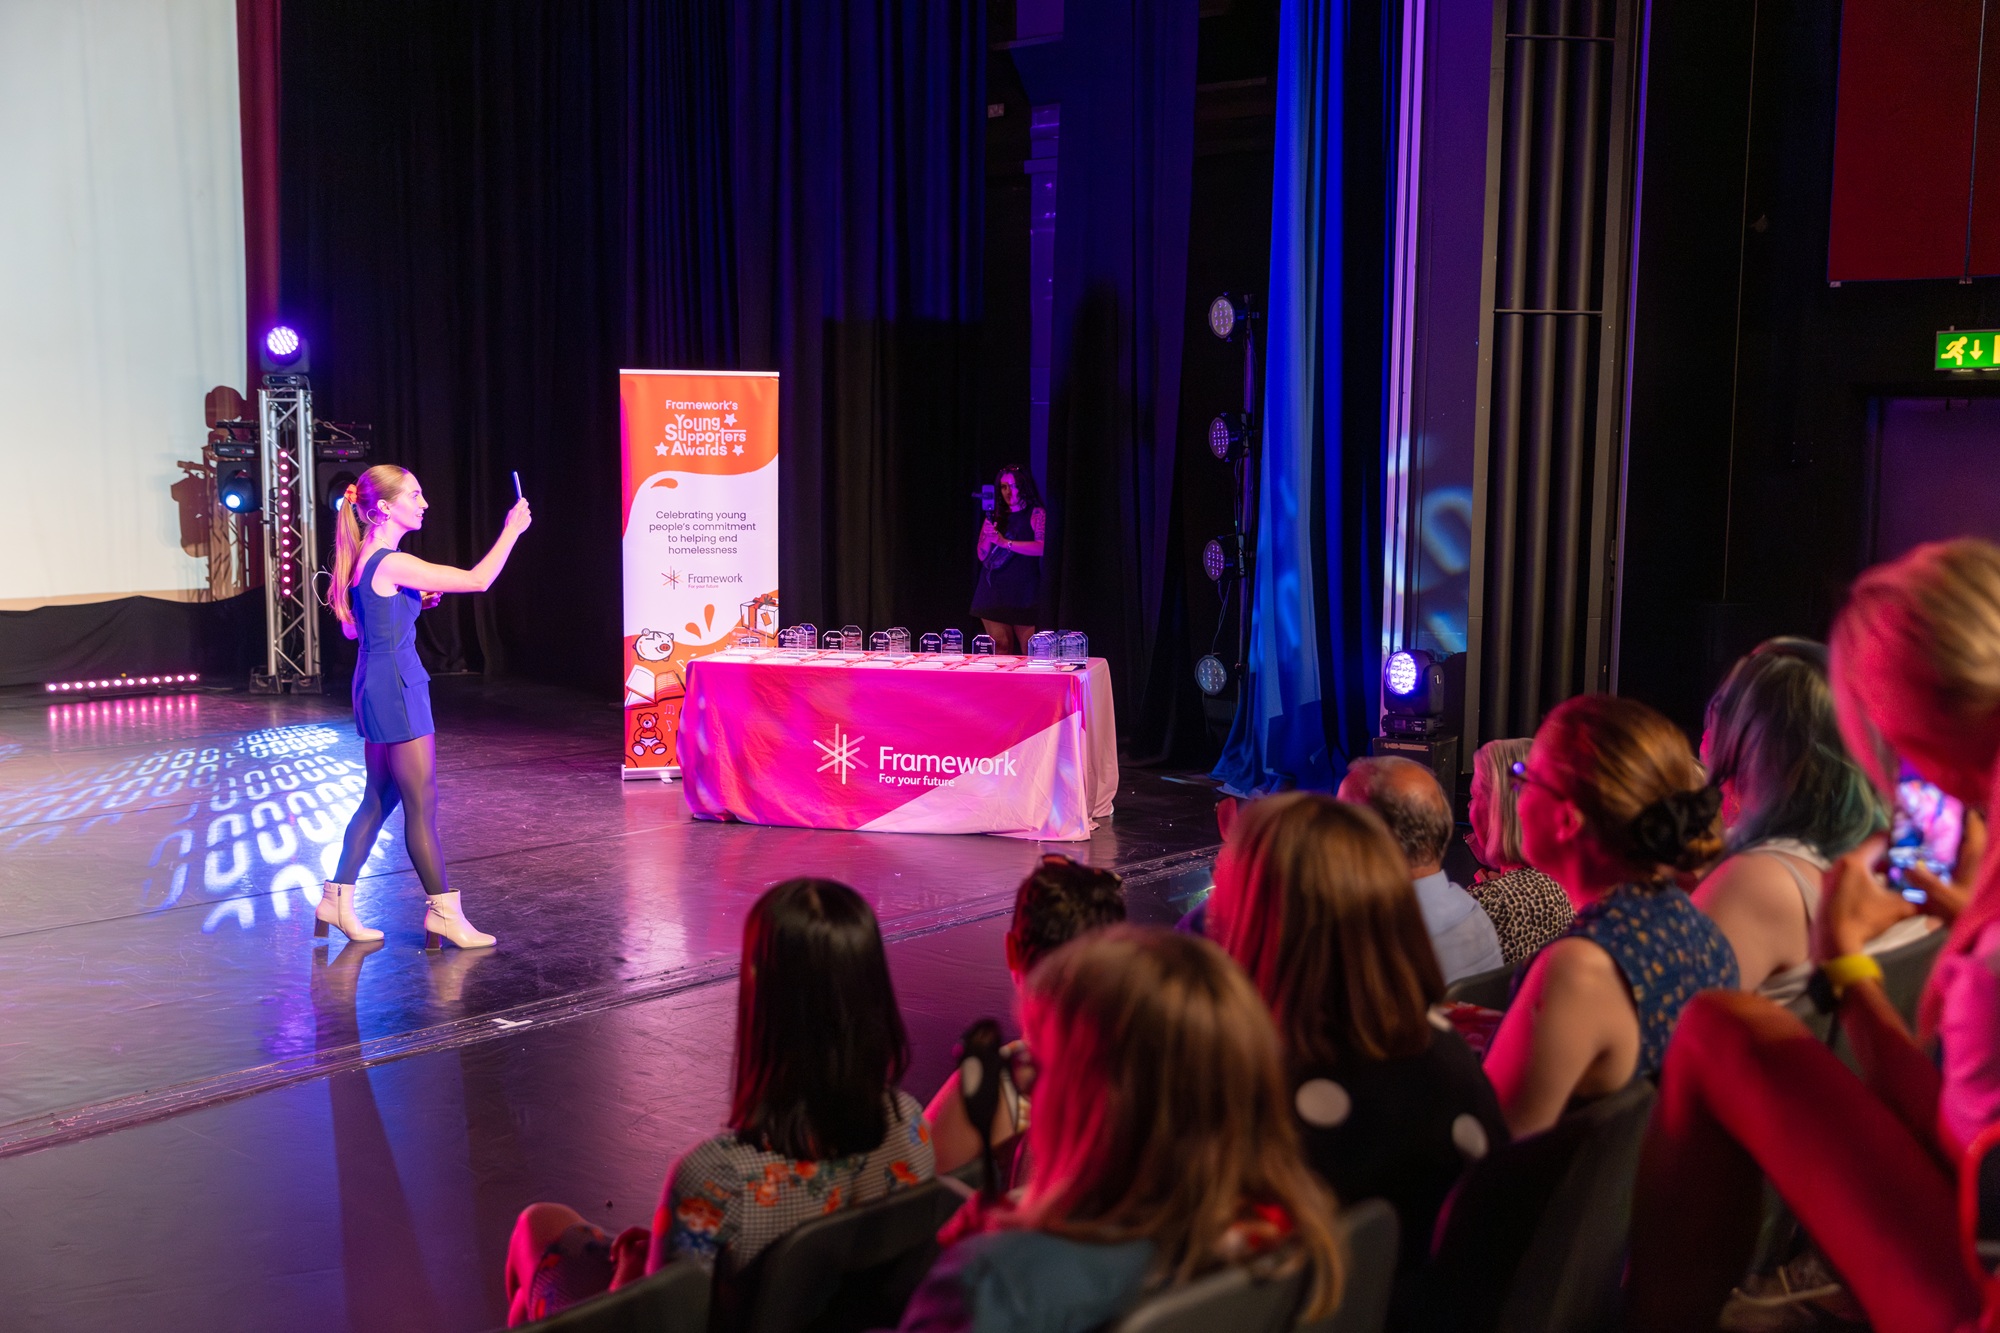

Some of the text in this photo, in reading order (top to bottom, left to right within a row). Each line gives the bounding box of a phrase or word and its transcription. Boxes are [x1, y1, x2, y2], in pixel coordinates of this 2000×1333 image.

[665, 399, 738, 410] Framework's
[674, 413, 720, 431] Young
[664, 423, 746, 446] Supporters
[670, 440, 728, 456] Awards
[655, 510, 746, 521] Celebrating young
[649, 522, 756, 533] people's commitment
[668, 534, 738, 545] to helping end
[668, 546, 738, 554] homelessness
[687, 573, 743, 583] Framework
[879, 746, 1017, 776] Framework
[879, 773, 955, 787] For your future
